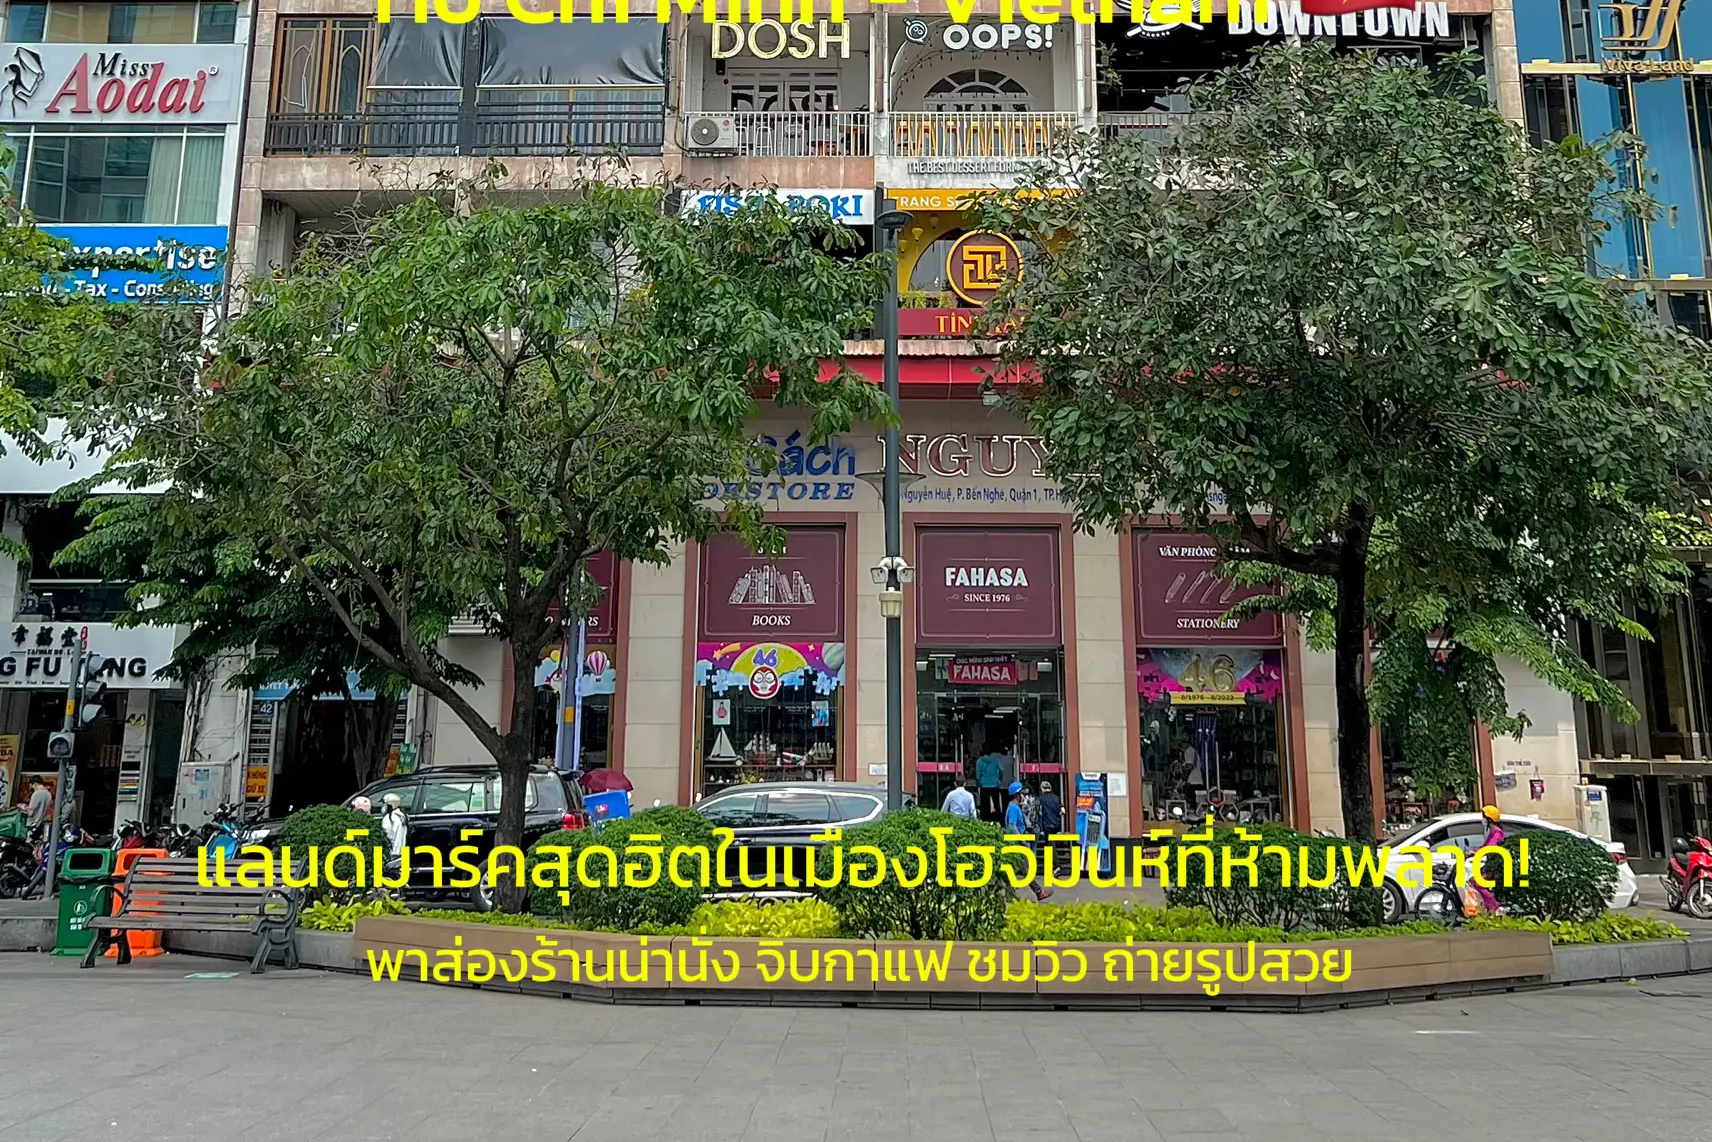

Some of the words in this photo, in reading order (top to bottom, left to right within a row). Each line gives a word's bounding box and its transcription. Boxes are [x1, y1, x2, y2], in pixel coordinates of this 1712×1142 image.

[711, 18, 851, 60] DOSH
[943, 23, 1053, 50] OOPS!
[93, 52, 150, 77] Miss
[45, 52, 208, 115] Aodai
[907, 161, 925, 174] THE
[926, 161, 949, 174] BEST
[952, 161, 992, 174] DESSERT
[73, 280, 107, 297] Tax
[876, 433, 1058, 477] NGUY
[1159, 545, 1179, 557] VĂN
[945, 567, 1029, 587] FAHASA
[964, 593, 991, 602] SINCE
[992, 593, 1011, 602] 1976
[752, 615, 792, 626] BOOKS
[1176, 618, 1240, 629] STATIONERY
[25, 656, 62, 677] FU
[953, 665, 1011, 681] FAHASA
[1178, 653, 1236, 692] 46
[260, 704, 273, 714] 42
